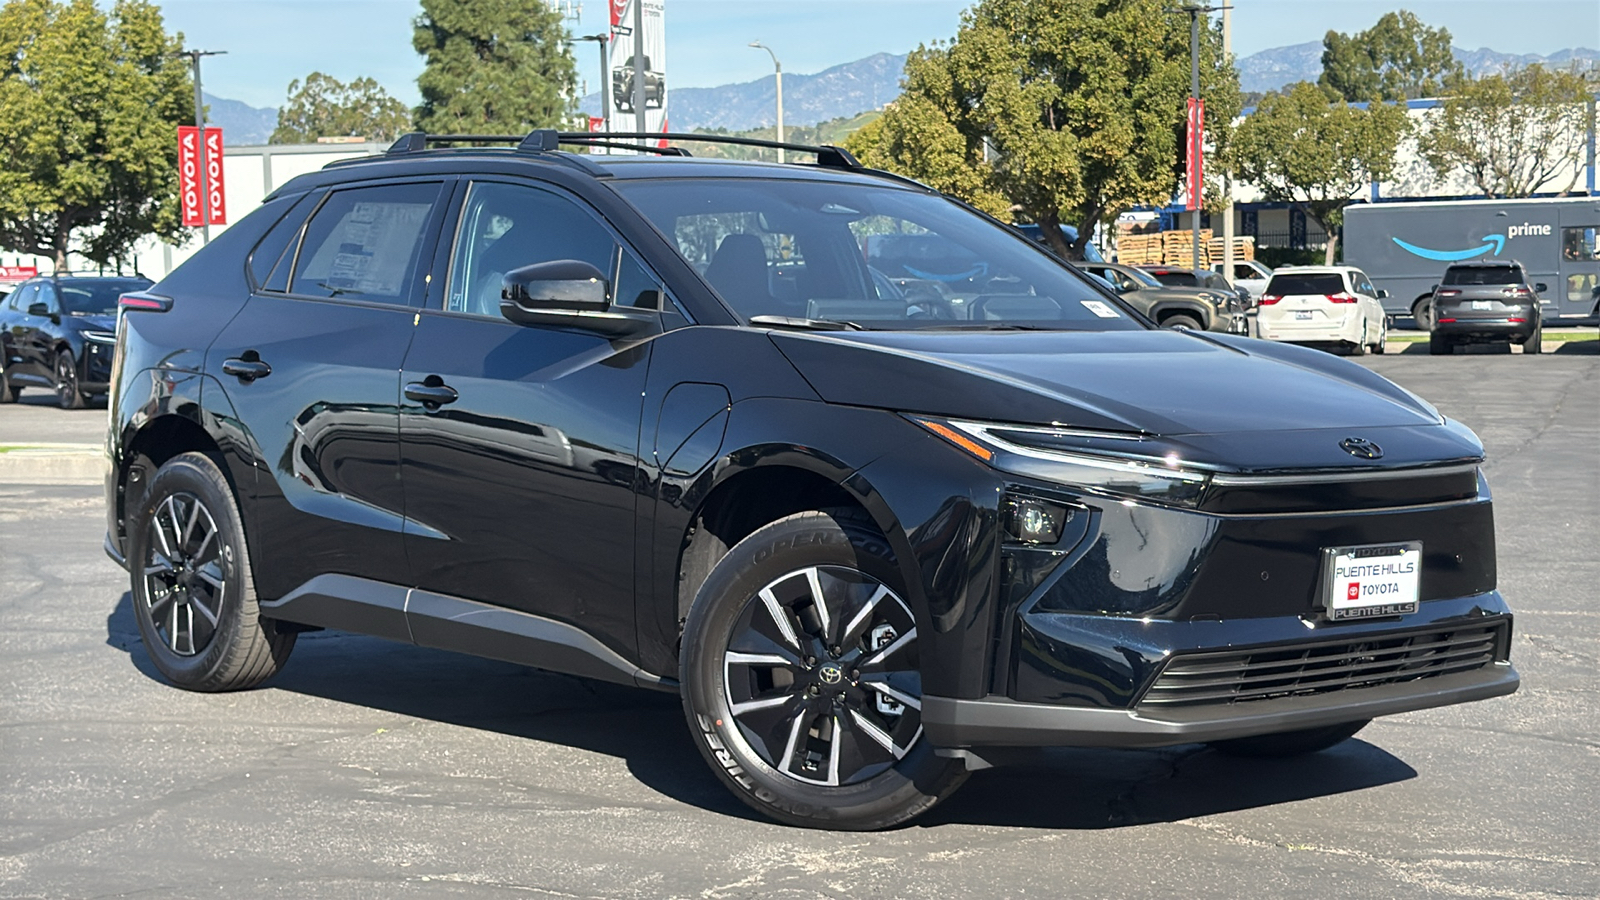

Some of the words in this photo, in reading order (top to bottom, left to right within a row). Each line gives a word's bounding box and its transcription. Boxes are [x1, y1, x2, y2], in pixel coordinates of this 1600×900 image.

[183, 133, 198, 221] TOYOTA
[207, 134, 222, 221] TOYOTA
[1508, 221, 1551, 239] prime
[1336, 564, 1380, 578] PUENTE
[1381, 562, 1414, 576] HILLS
[1362, 583, 1399, 596] TOYOTA
[1335, 606, 1380, 618] PUENTE
[1381, 603, 1414, 615] HILLS
[697, 713, 754, 790] TIRES
